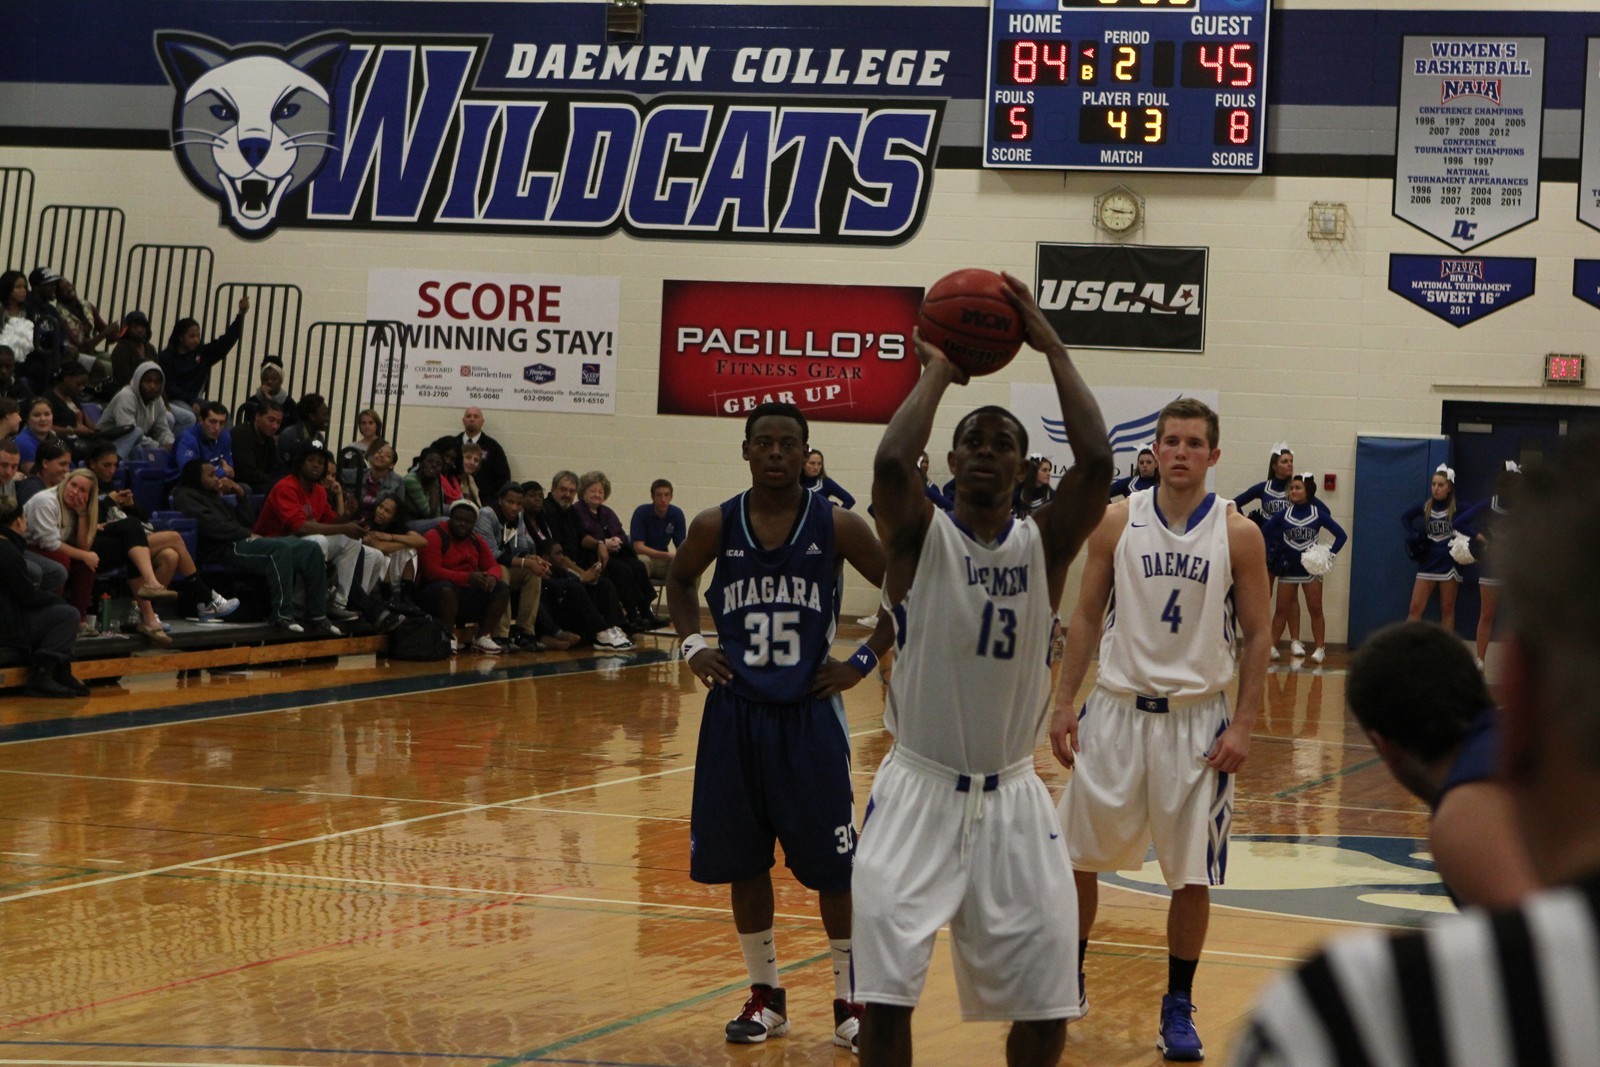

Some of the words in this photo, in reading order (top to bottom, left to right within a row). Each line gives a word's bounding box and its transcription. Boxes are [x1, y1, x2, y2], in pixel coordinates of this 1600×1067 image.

[1008, 14, 1062, 33] HOME
[1190, 15, 1252, 36] GUEST
[1104, 31, 1150, 44] PERIOD
[1431, 42, 1517, 58] WOMEN'S
[504, 43, 711, 82] DAEMEN
[730, 47, 951, 86] COLLEGE
[1012, 41, 1067, 83] 84
[1115, 46, 1136, 81] 2
[1199, 44, 1252, 87] 45
[1414, 59, 1532, 76] BASKETBALL
[1081, 64, 1094, 80] B
[995, 90, 1035, 105] FOULS
[1082, 91, 1131, 106] PLAYER
[1137, 92, 1169, 107] FOUL
[1442, 79, 1501, 104] NAIA
[1215, 93, 1256, 108] FOULS
[1419, 106, 1473, 115] CONFERENCE
[1474, 107, 1524, 116] CHAMPIONS
[1008, 106, 1028, 140] 5
[1107, 110, 1127, 140] 4
[1144, 108, 1162, 143] 3
[1229, 110, 1250, 144] 8
[1414, 117, 1435, 126] 1996
[1444, 117, 1465, 126] 1997
[1474, 118, 1495, 127] 2004
[1505, 118, 1526, 127] 2005
[306, 43, 937, 237] WILDCATS
[1429, 127, 1450, 136] 2007
[1459, 127, 1480, 136] 2008
[1489, 128, 1510, 137] 2012
[1442, 138, 1497, 147] CONFERENCE
[991, 148, 1032, 162] SCORE
[1100, 150, 1143, 164] MATCH
[1212, 152, 1254, 166] SCORE
[1414, 146, 1474, 155] TOURNAMENT
[1475, 147, 1525, 156] CHAMPIONS
[1443, 156, 1464, 165] 1996
[1473, 157, 1494, 166] 1997
[1407, 175, 1467, 185] TOURNAMENT
[1468, 176, 1529, 186] APPEARANCES
[1446, 168, 1490, 177] NATIONAL
[1411, 185, 1432, 194] 1996
[1441, 186, 1462, 195] 1997
[1470, 187, 1492, 196] 2004
[1501, 187, 1523, 197] 2005
[1440, 196, 1461, 205] 2007
[1470, 197, 1492, 206] 2008
[1500, 197, 1522, 207] 2011
[1454, 207, 1476, 216] 2012
[1451, 219, 1478, 241] DC
[1441, 260, 1484, 279] NAIA
[1411, 281, 1453, 290] NATIONAL
[1454, 282, 1512, 292] TOURNAMENT
[1450, 274, 1465, 282] DIV.
[1466, 275, 1474, 283] II
[417, 280, 562, 323] SCORE
[1038, 278, 1202, 315] USCAA
[1421, 290, 1476, 304] "SWEET
[1449, 306, 1471, 315] 2011
[370, 325, 389, 348] A
[398, 324, 528, 353] WINNING
[535, 328, 614, 357] STAY!
[676, 327, 905, 361] PACILLO'S
[414, 366, 453, 374] COURTYARD
[469, 392, 500, 400] 565-0040
[723, 390, 797, 413] GEAR
[805, 384, 842, 402] UP
[965, 556, 1028, 596] DEMEN
[722, 575, 822, 616] NIAGARA
[1160, 588, 1183, 634] 4
[976, 600, 1018, 660] 13
[743, 610, 801, 667] 35
